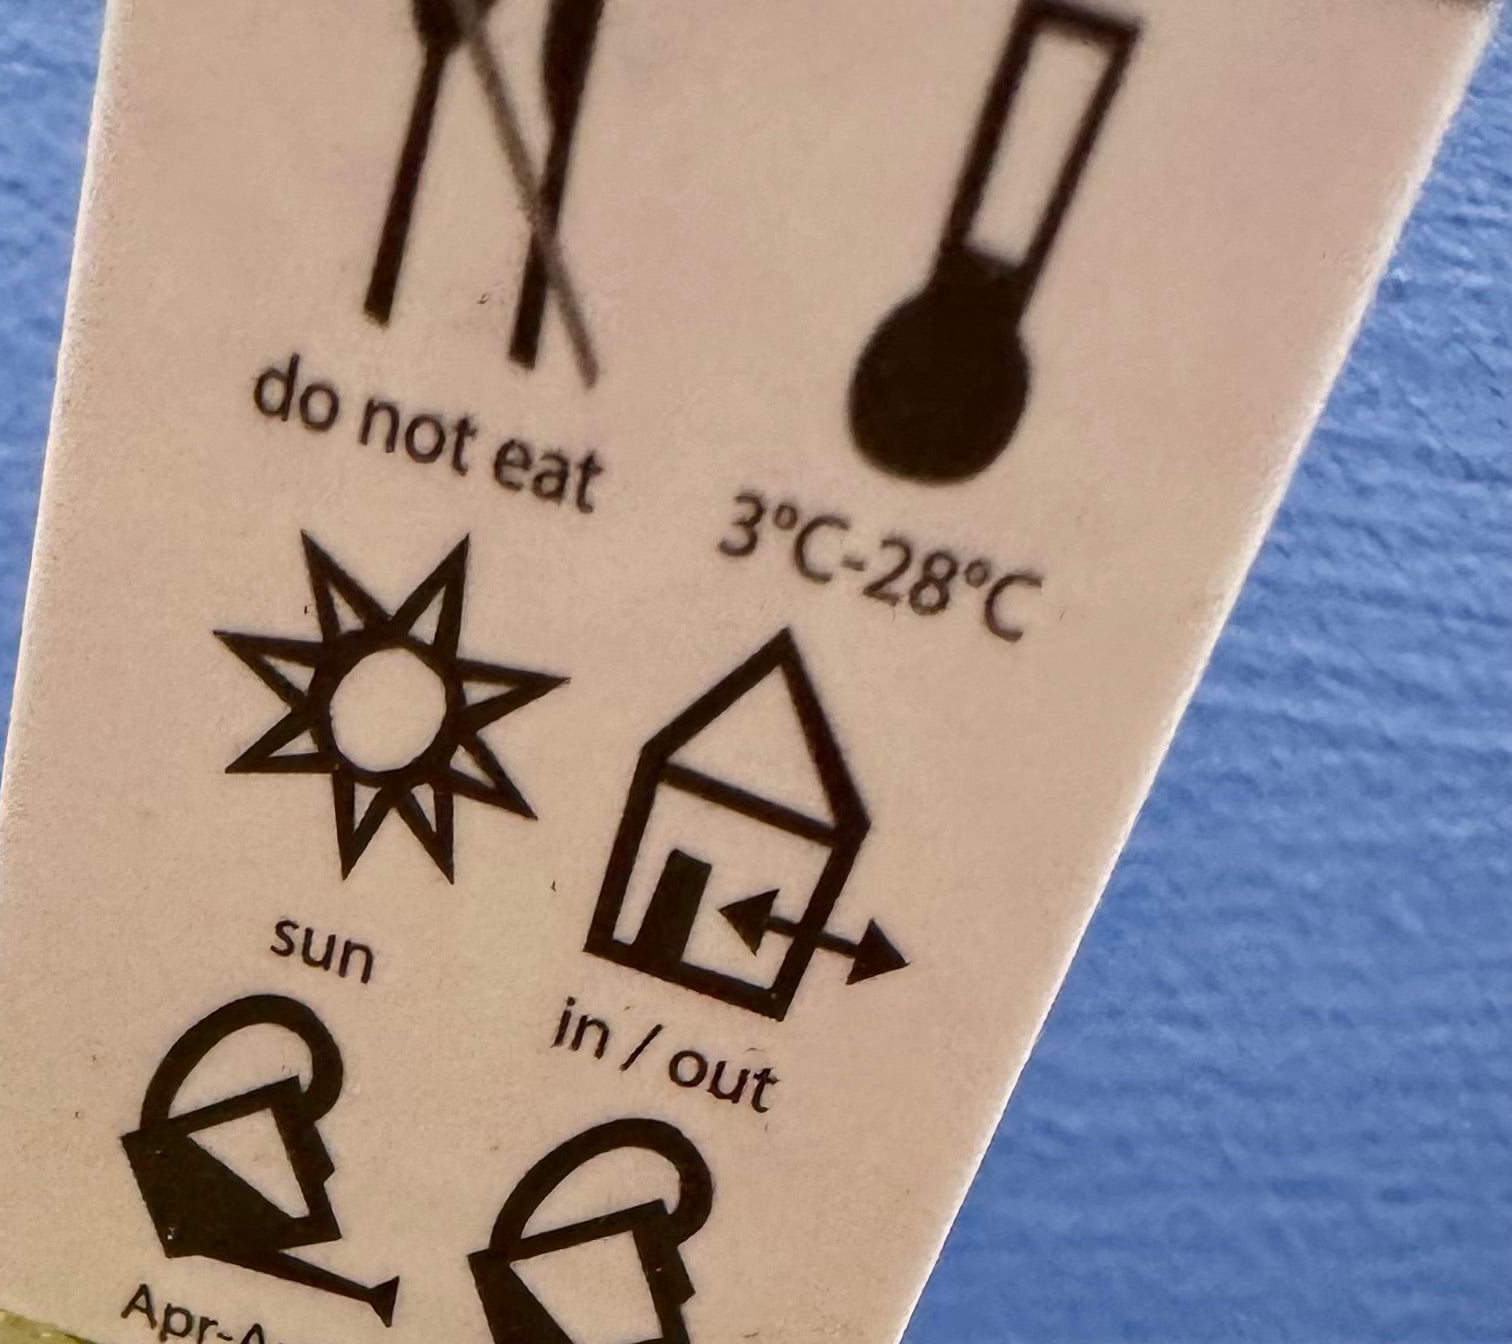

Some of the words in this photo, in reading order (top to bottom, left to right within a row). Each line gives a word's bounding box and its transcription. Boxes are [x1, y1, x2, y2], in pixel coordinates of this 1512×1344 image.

[252, 351, 341, 434] do
[358, 396, 479, 478] not
[491, 437, 605, 515] eat
[269, 918, 375, 986] sun
[550, 995, 611, 1061] in
[619, 1022, 665, 1073] /
[667, 1049, 781, 1115] out
